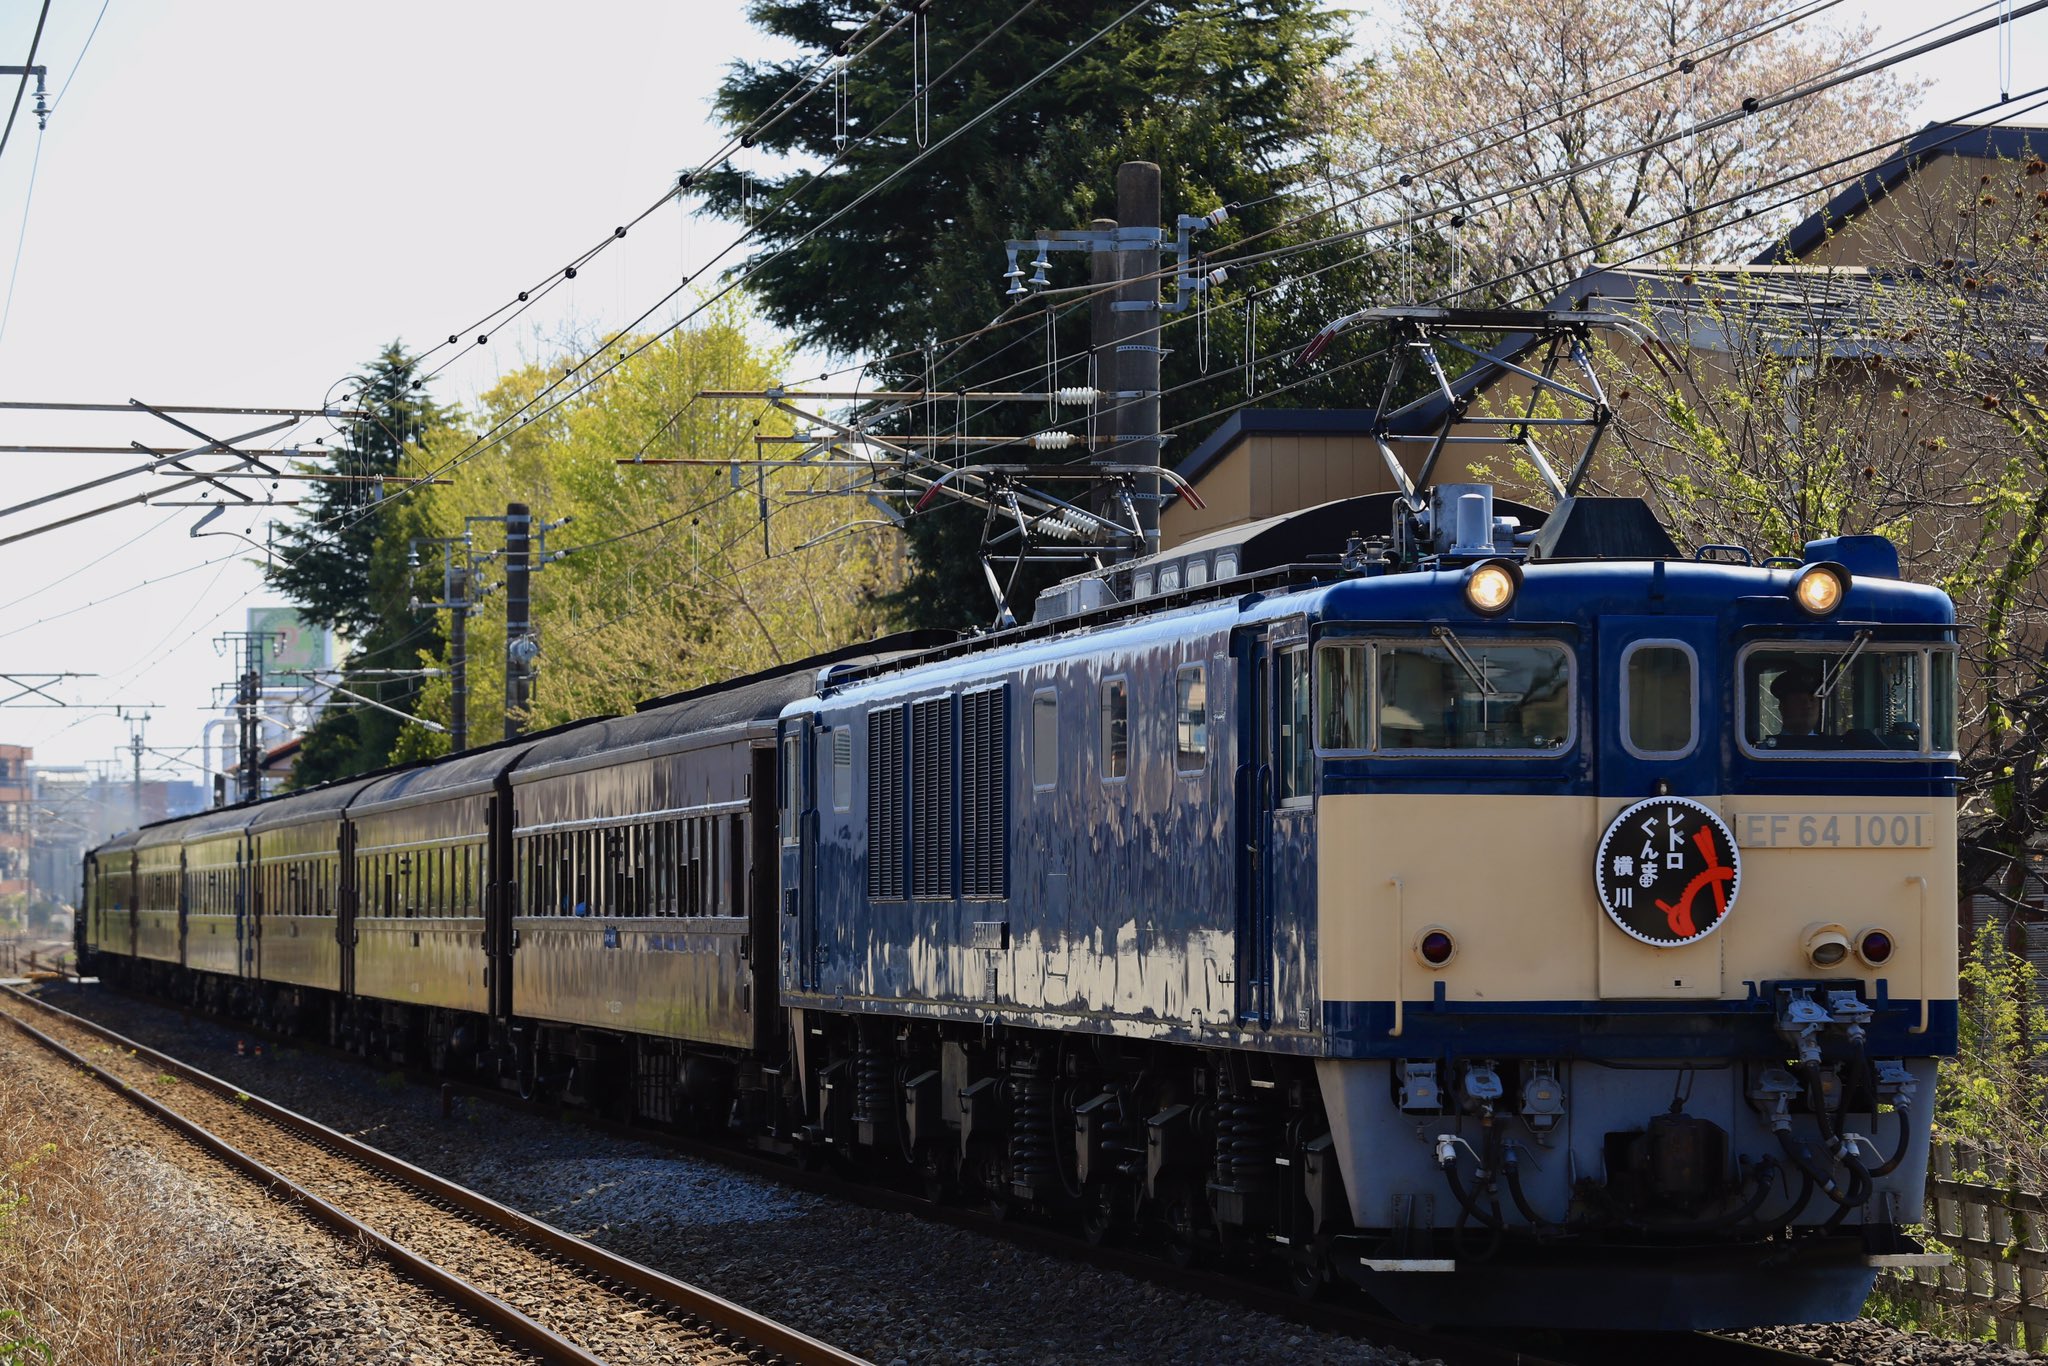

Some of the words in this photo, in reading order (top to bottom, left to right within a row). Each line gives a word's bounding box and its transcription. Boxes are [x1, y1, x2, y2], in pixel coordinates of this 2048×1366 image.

[1639, 816, 1659, 888] ぐんま
[1667, 807, 1685, 870] レトロ
[1855, 815, 1921, 847] 1001
[1613, 855, 1634, 908] 横川
